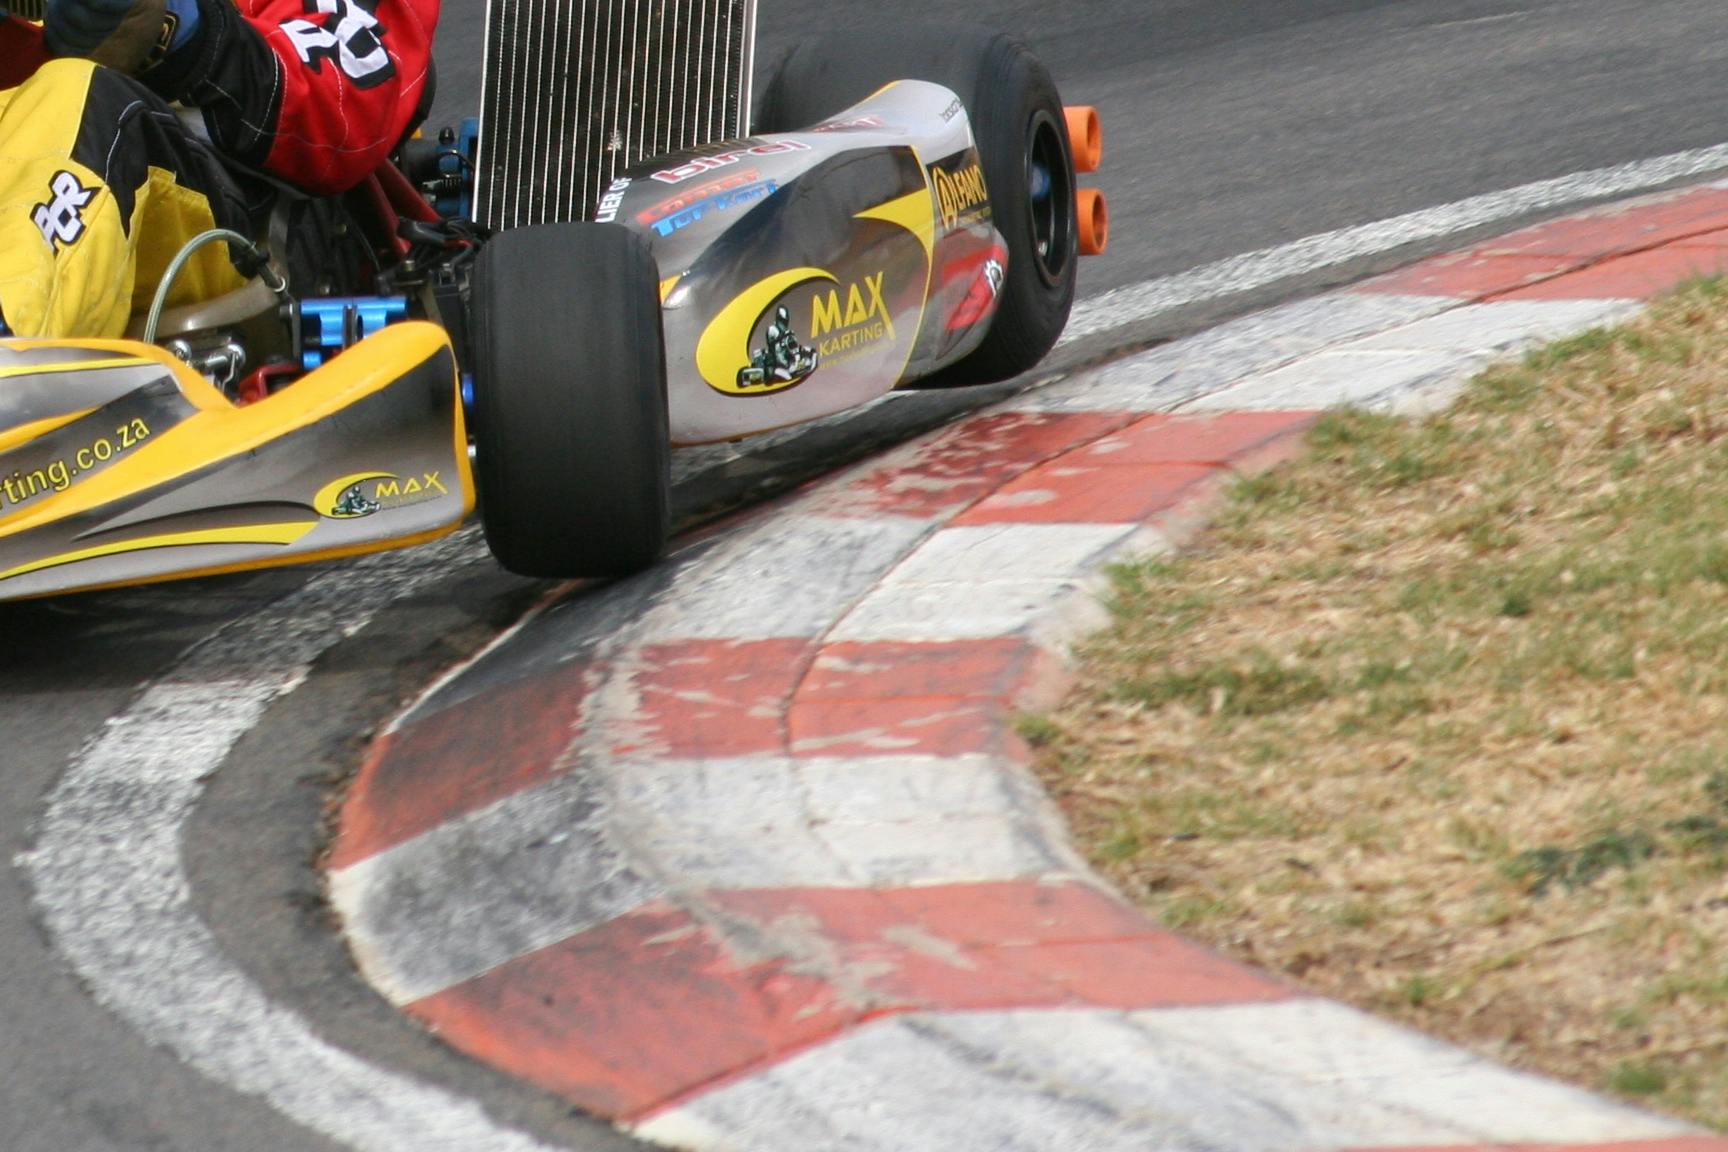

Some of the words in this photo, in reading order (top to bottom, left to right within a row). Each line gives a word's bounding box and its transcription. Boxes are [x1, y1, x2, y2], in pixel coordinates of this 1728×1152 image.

[608, 177, 633, 192] OF
[932, 164, 988, 232] ALFANO
[810, 271, 897, 341] MAX
[818, 321, 885, 357] KARTING
[376, 470, 448, 498] MAX
